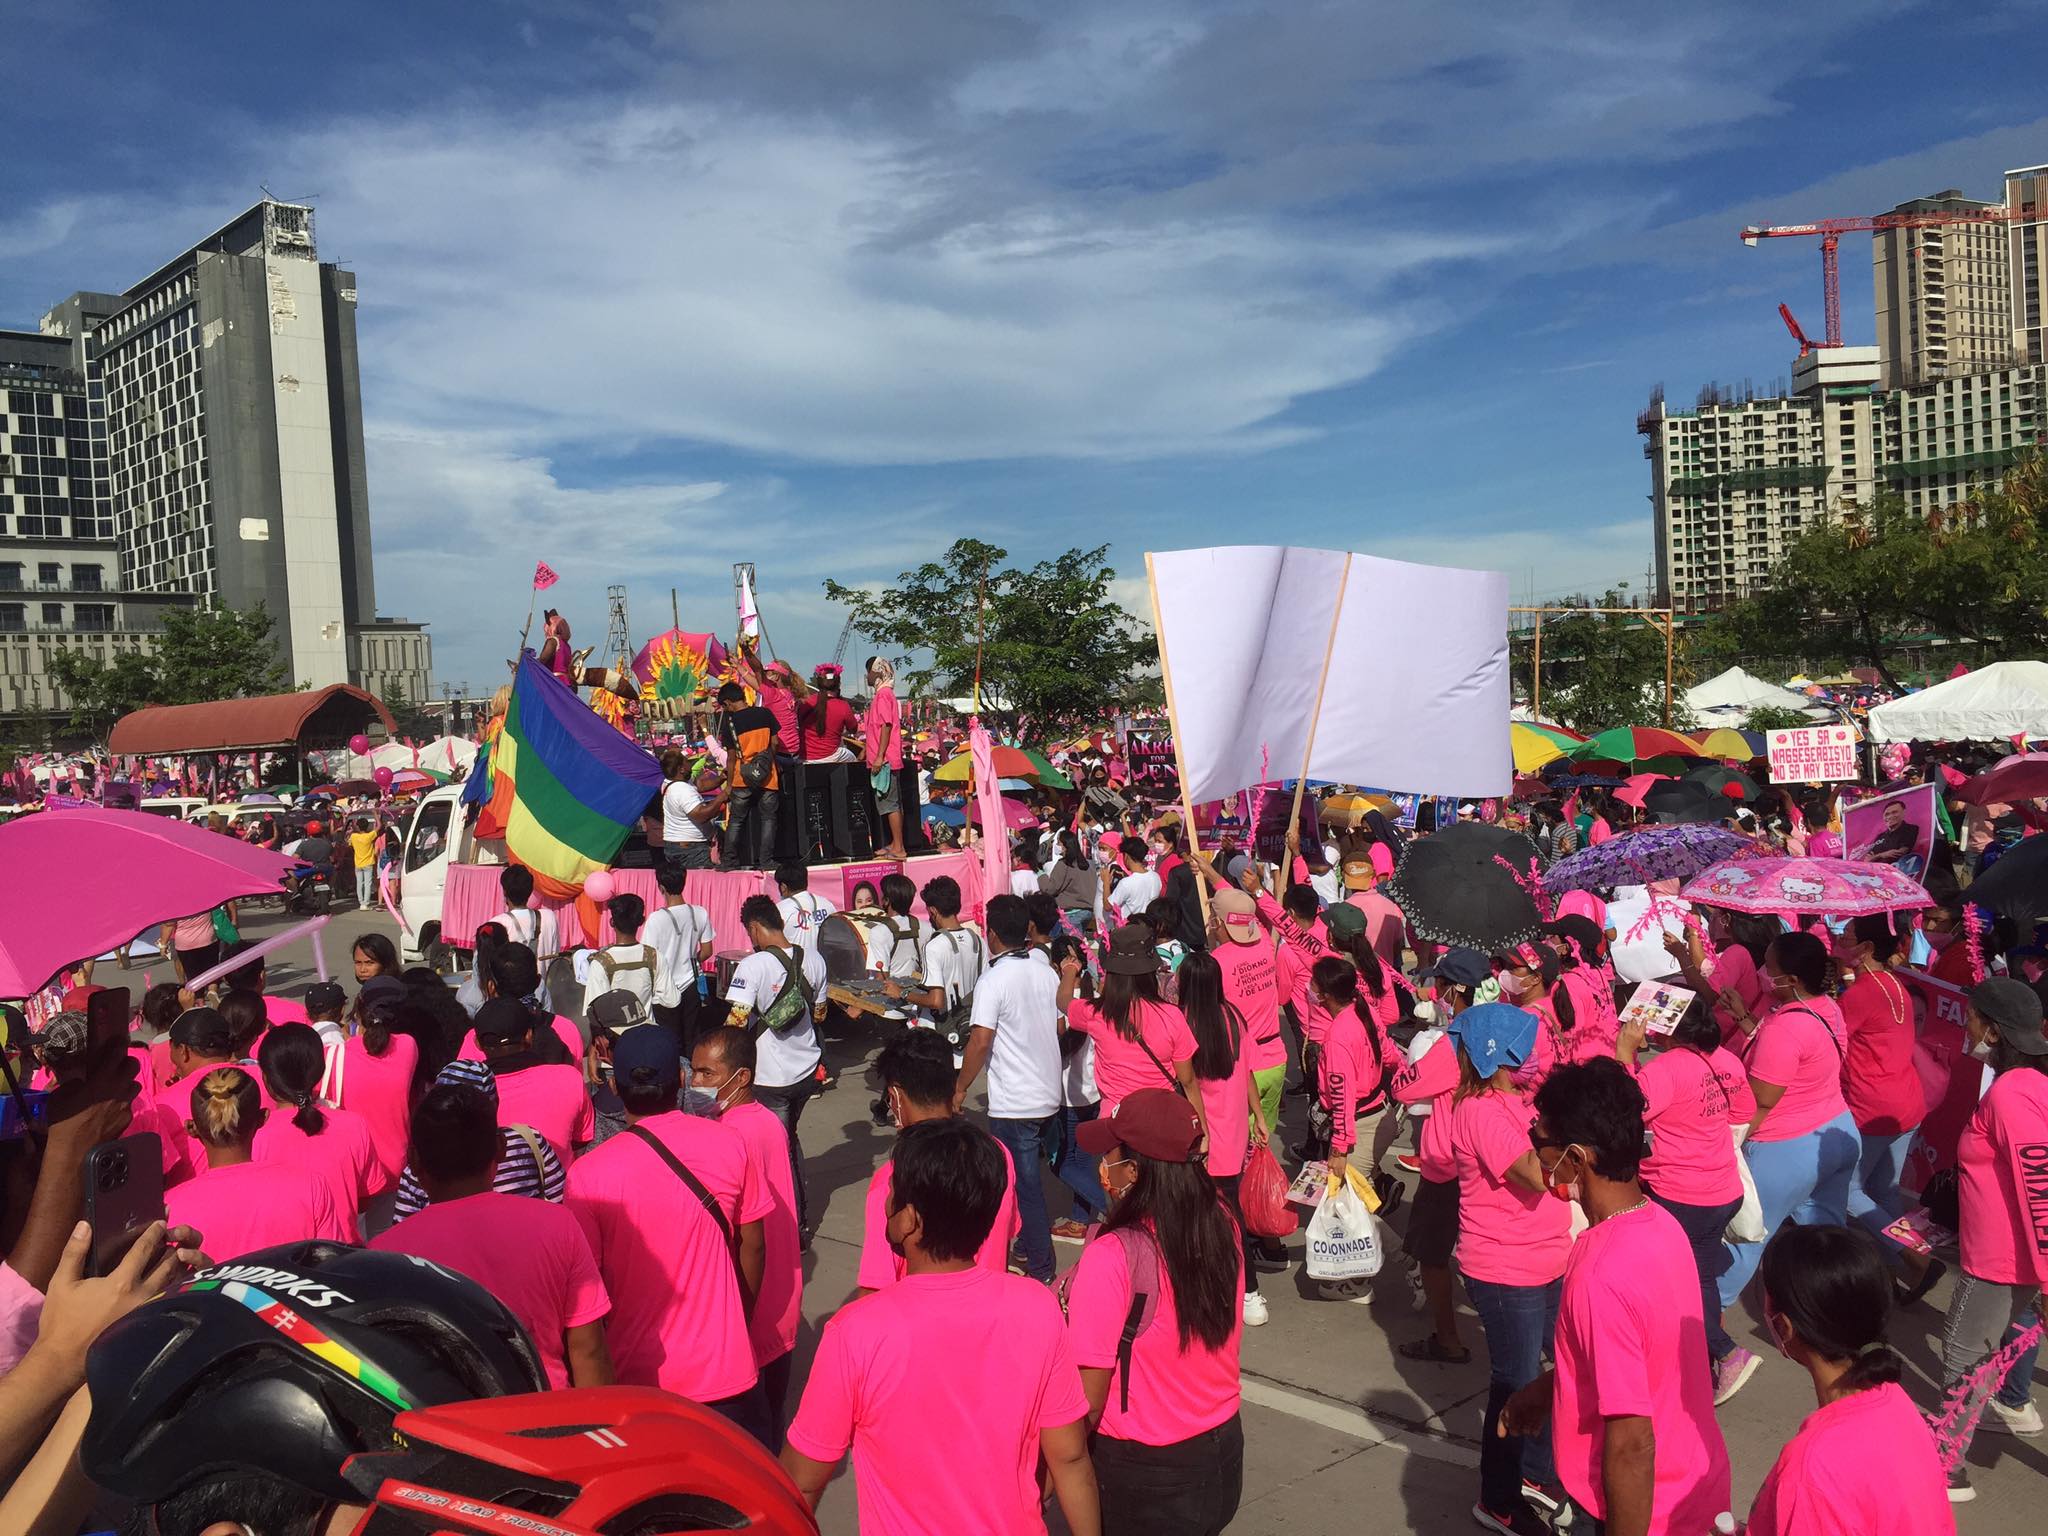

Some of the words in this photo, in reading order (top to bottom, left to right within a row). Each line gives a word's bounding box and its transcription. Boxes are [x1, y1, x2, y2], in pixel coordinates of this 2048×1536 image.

[1131, 738, 1175, 754] AKRH
[1790, 731, 1809, 746] YES
[1817, 730, 1830, 745] SA
[1150, 755, 1166, 763] FOR
[1772, 745, 1852, 764] NAGSESERBISYO
[1773, 765, 1786, 780] NO
[1789, 764, 1801, 780] SA
[1804, 762, 1820, 779] MAY
[1824, 762, 1853, 778] BISYO
[1825, 838, 1842, 849] LEN
[1245, 988, 1256, 997] DE
[620, 1000, 647, 1023] LA
[183, 1265, 356, 1308] S-WORKS
[393, 1486, 450, 1507] SUPER
